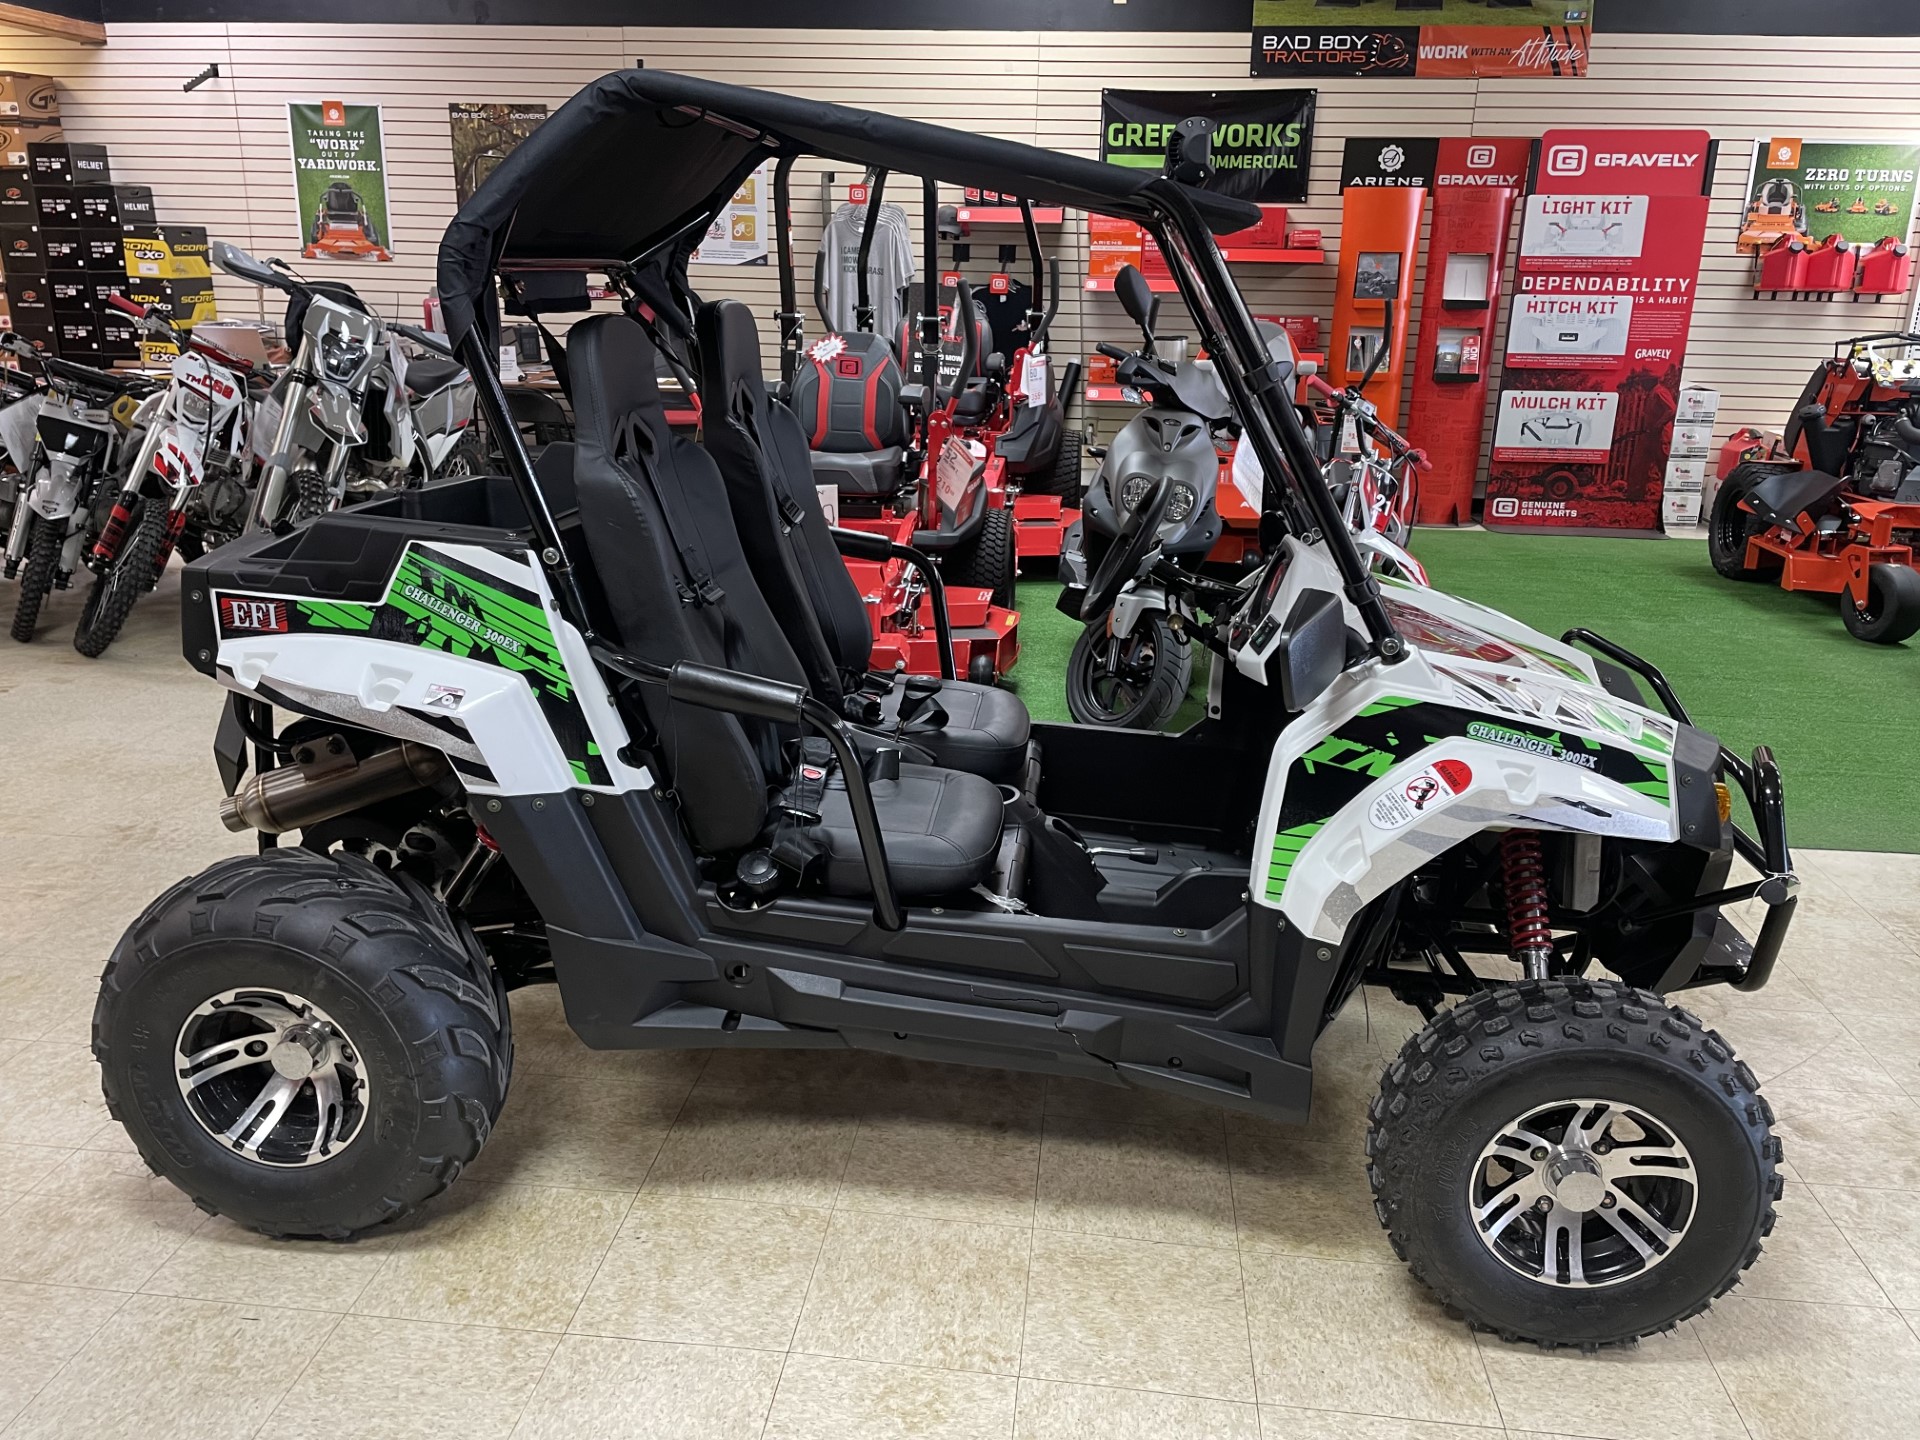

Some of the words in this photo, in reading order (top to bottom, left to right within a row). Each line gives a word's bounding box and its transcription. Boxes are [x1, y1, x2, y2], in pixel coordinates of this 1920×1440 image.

[1262, 35, 1311, 50] BAD
[1319, 35, 1369, 50] BOY
[1263, 50, 1367, 63] TRACTORS
[1419, 45, 1470, 60] WORK
[1471, 47, 1496, 56] WITH
[1498, 47, 1512, 56] AN
[1507, 34, 1584, 70] Attitude
[307, 129, 341, 137] TAKING
[346, 130, 365, 138] THE
[1107, 122, 1301, 148] GREEWORKS
[77, 160, 104, 170] HELMET
[297, 158, 381, 171] YARDWORK.
[1208, 154, 1299, 169] OMMERCIAL
[1594, 153, 1699, 167] GRAVELY
[1350, 176, 1425, 186] ARIENS
[1437, 174, 1518, 186] GRAVELY
[1805, 167, 1849, 182] ZERO
[1854, 168, 1914, 183] TURNS
[1804, 183, 1826, 191] WITH
[123, 203, 150, 211] HELMET
[1542, 201, 1595, 215] LIGHT
[1600, 201, 1633, 215] KIT
[1521, 276, 1691, 292] DEPENDABILITY
[1635, 296, 1645, 304] IS
[1648, 296, 1655, 304] A
[1658, 296, 1688, 304] HABIT
[1526, 300, 1582, 314] HITCH
[1587, 301, 1619, 315] KIT
[1634, 348, 1672, 360] GRAVELY
[1510, 396, 1571, 410] MULCH
[1576, 397, 1608, 411] KIT
[1521, 501, 1566, 509] GENUINE
[1520, 508, 1543, 516] OEM
[1545, 509, 1578, 517] PARTS
[229, 601, 280, 629] EFI
[404, 585, 482, 633] CHALLENGER
[483, 628, 522, 653] 300EX
[1468, 724, 1555, 757] CHALLENGER
[1557, 748, 1598, 769] 300EX
